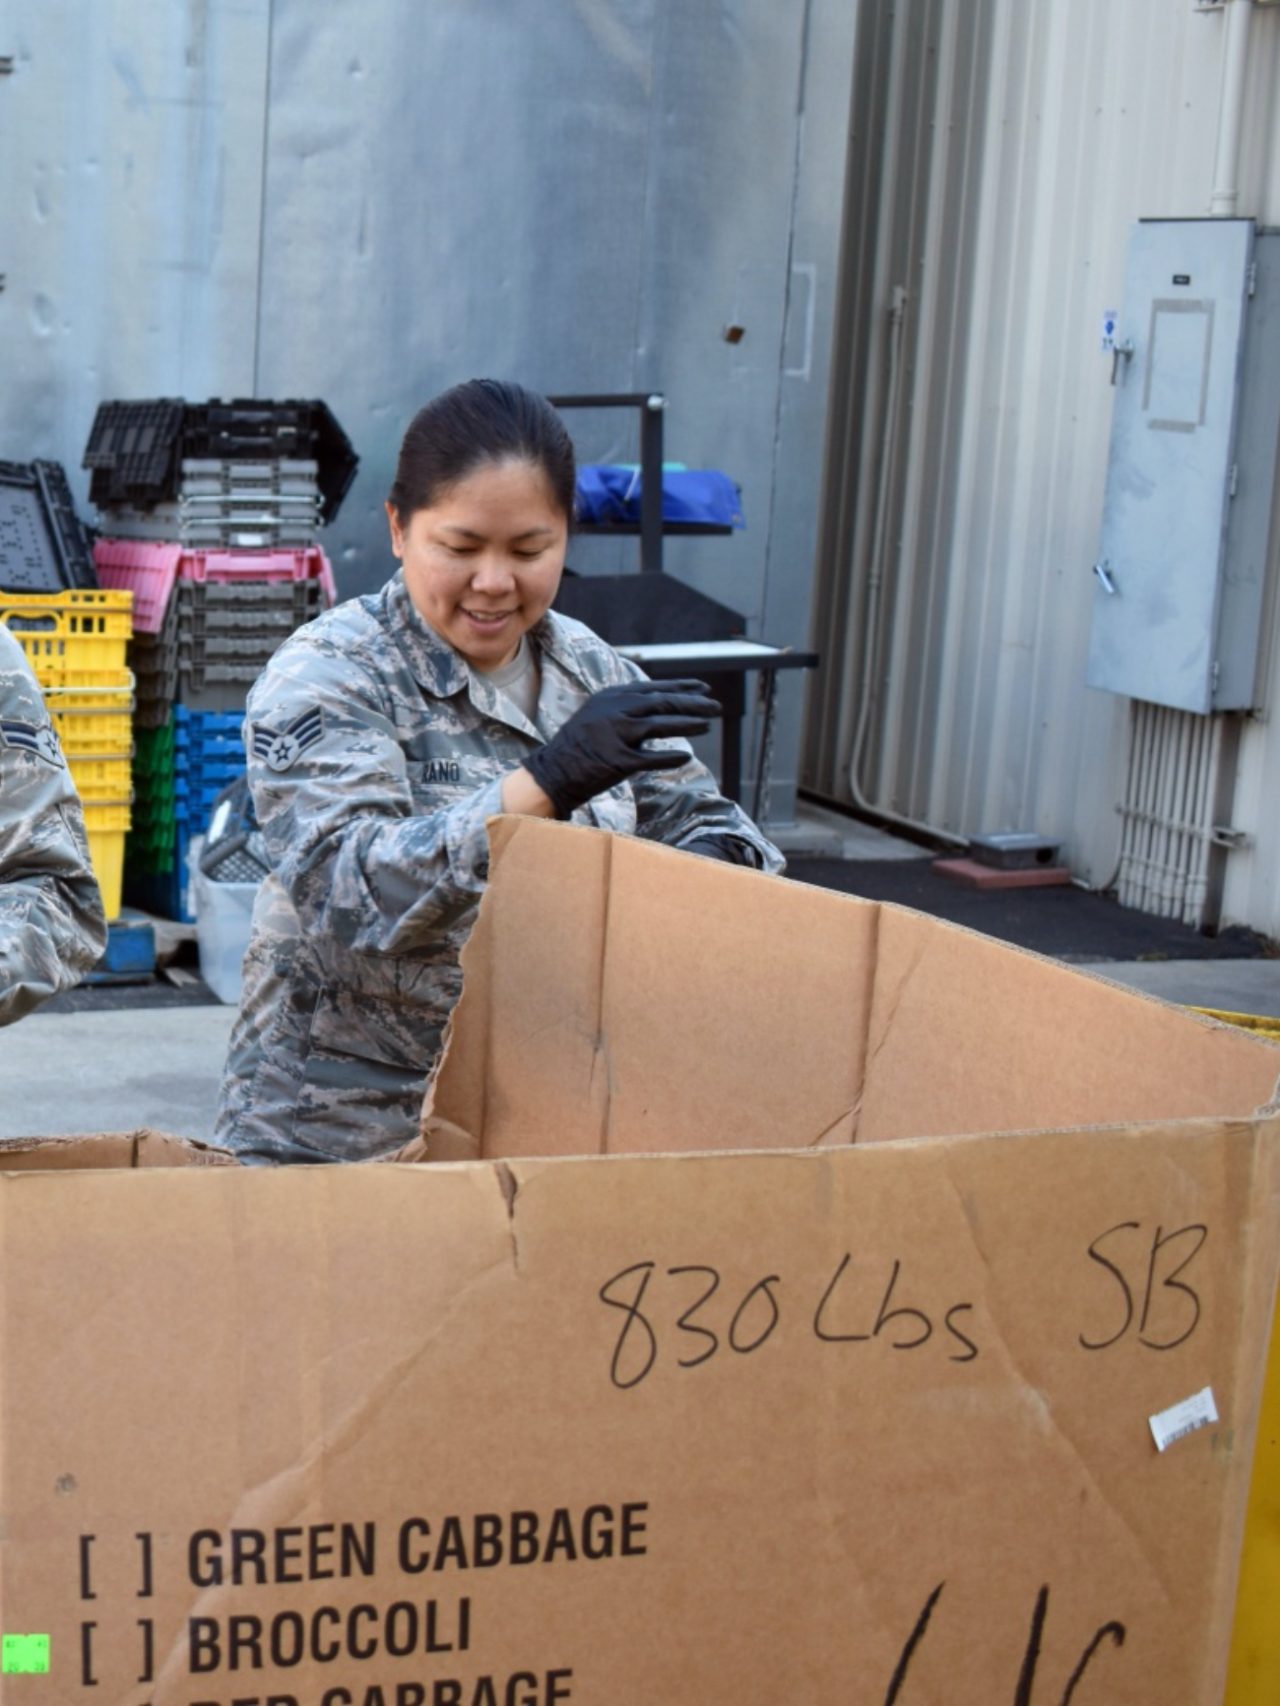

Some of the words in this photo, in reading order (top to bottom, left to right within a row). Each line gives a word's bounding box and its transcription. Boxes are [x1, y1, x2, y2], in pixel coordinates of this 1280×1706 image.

[597, 1260, 782, 1391] 830
[1077, 1221, 1210, 1353] SB
[187, 1520, 377, 1589] GREEN
[397, 1500, 650, 1576] CABBAGE
[188, 1596, 472, 1675] BROCCOLI
